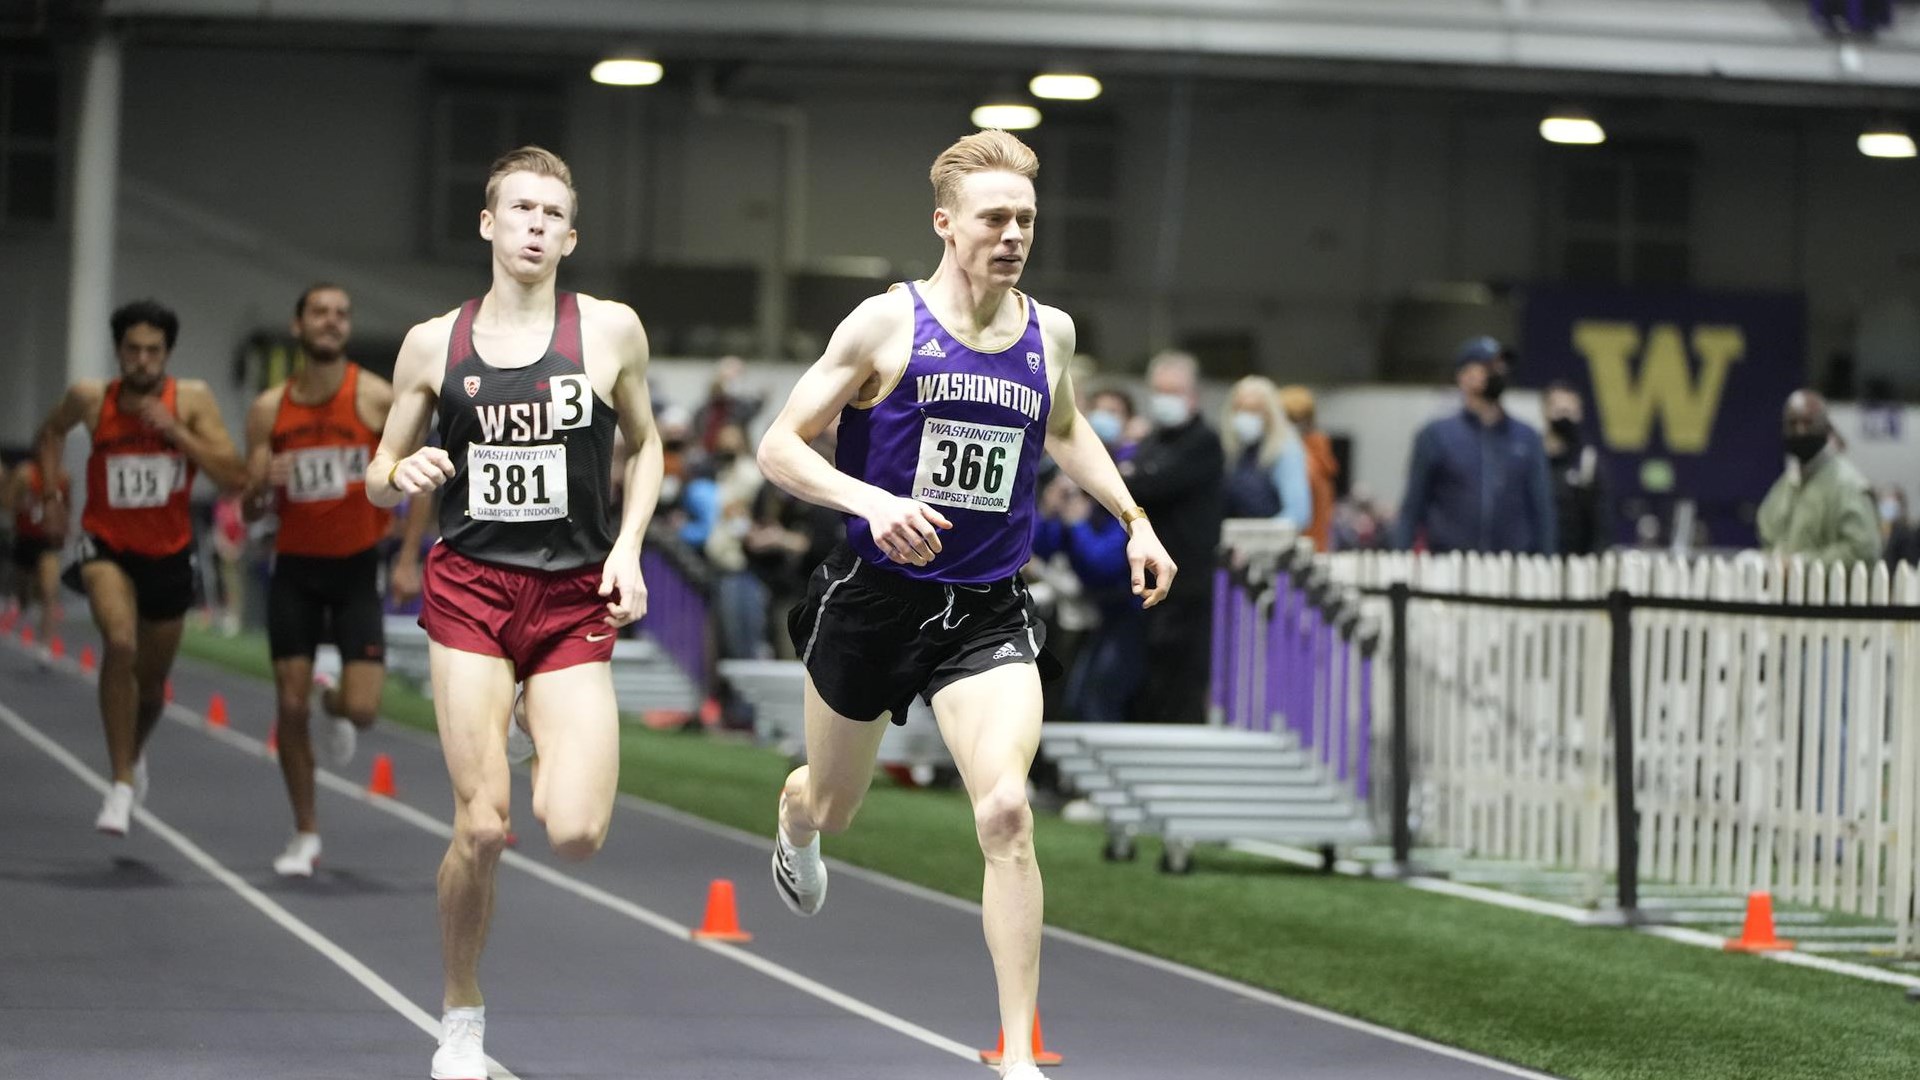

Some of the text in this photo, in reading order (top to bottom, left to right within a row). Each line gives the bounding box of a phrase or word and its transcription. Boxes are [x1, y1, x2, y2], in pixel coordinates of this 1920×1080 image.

[917, 349, 947, 358] adidas
[560, 378, 584, 427] 3
[916, 372, 1043, 421] WASHINGTON
[1573, 320, 1746, 452] W
[475, 402, 554, 442] WSU
[930, 422, 1017, 444] WASHINGTON
[473, 449, 558, 461] WASHINGTON
[932, 440, 1007, 494] 366
[482, 463, 551, 506] 381
[922, 487, 1005, 507] DEMPSEY INDOOR
[477, 506, 561, 518] DEMPSEY INDOOR
